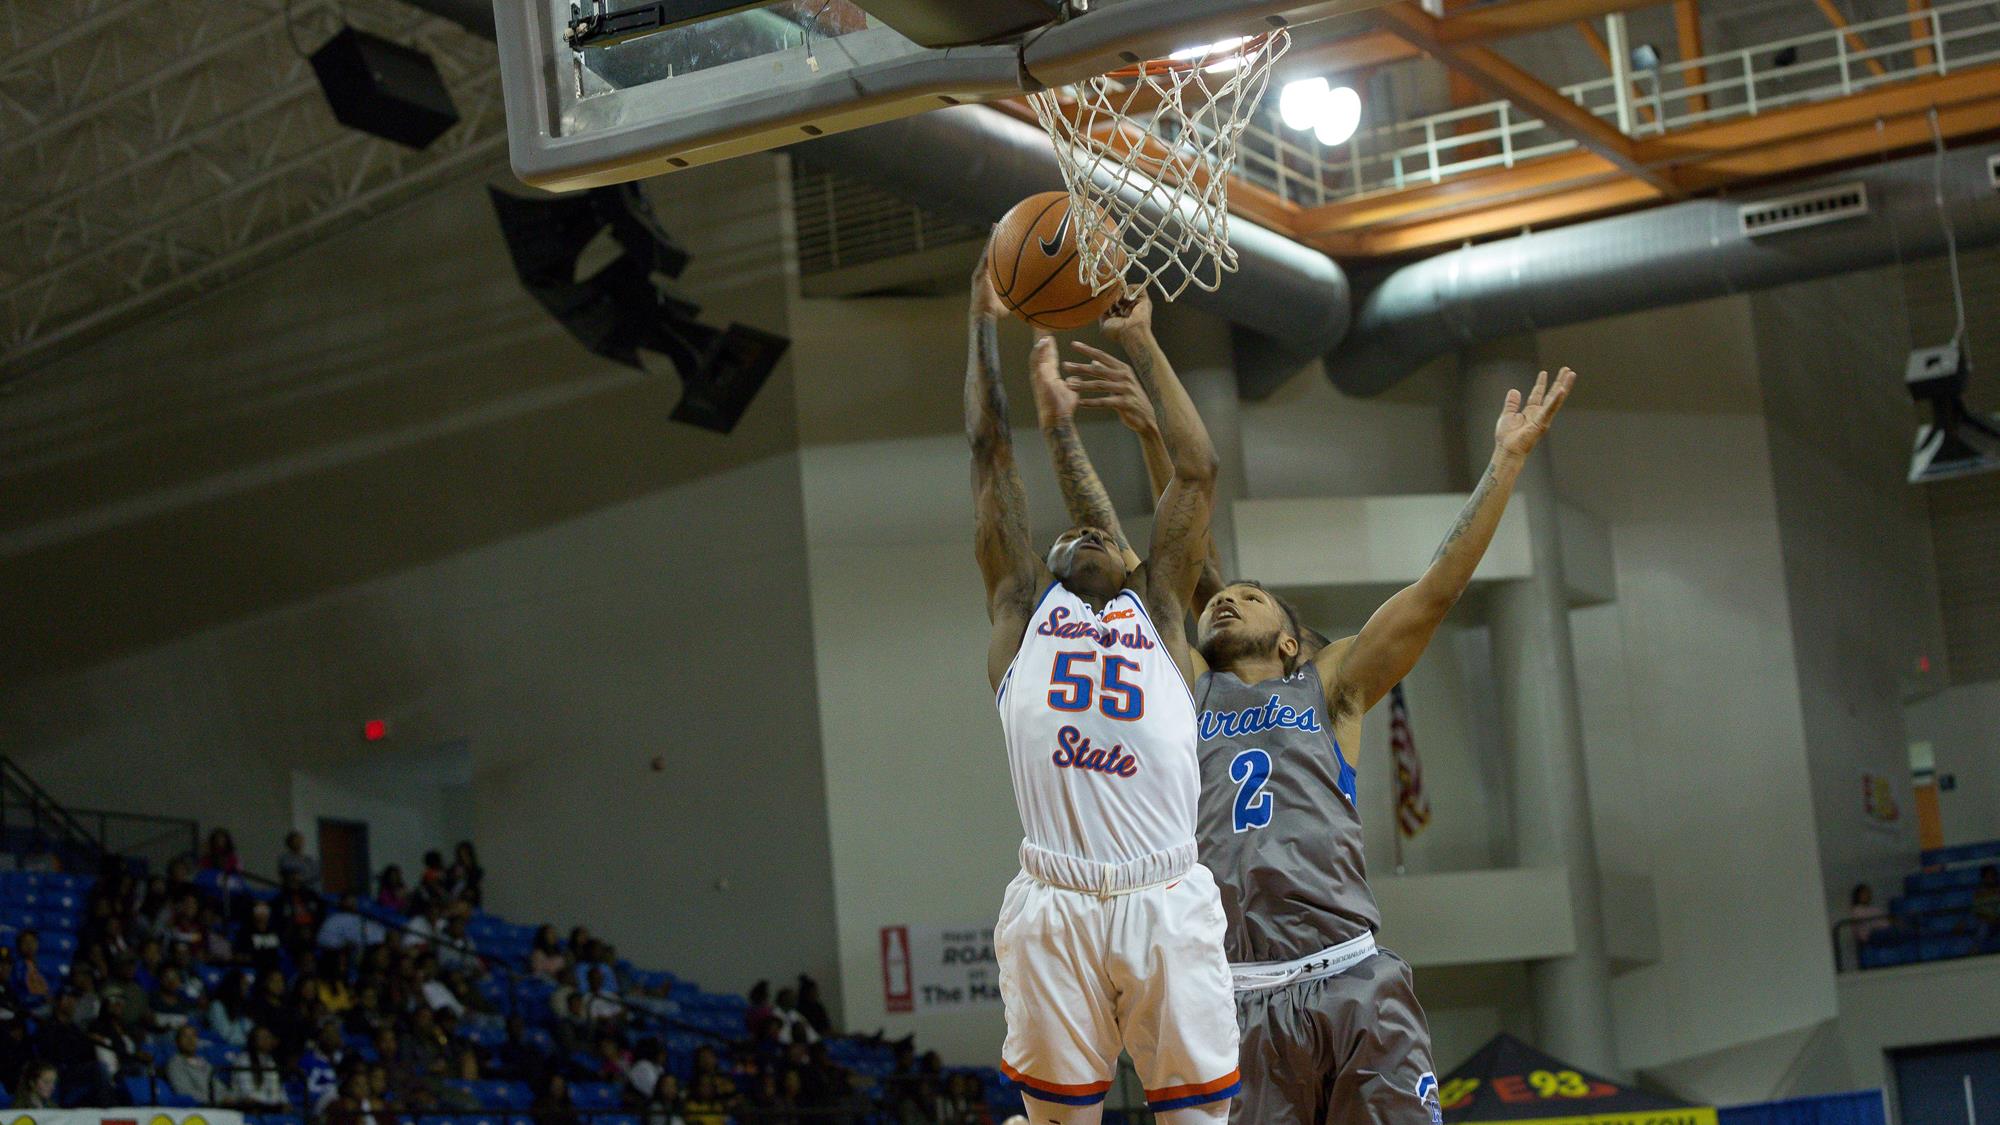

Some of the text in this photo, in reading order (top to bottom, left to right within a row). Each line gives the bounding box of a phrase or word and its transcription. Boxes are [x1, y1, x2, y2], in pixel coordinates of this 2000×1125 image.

[1047, 650, 1145, 722] 55
[1198, 694, 1321, 742] irates
[1052, 726, 1138, 778] State
[1229, 749, 1273, 834] 2
[943, 946, 997, 964] ROA
